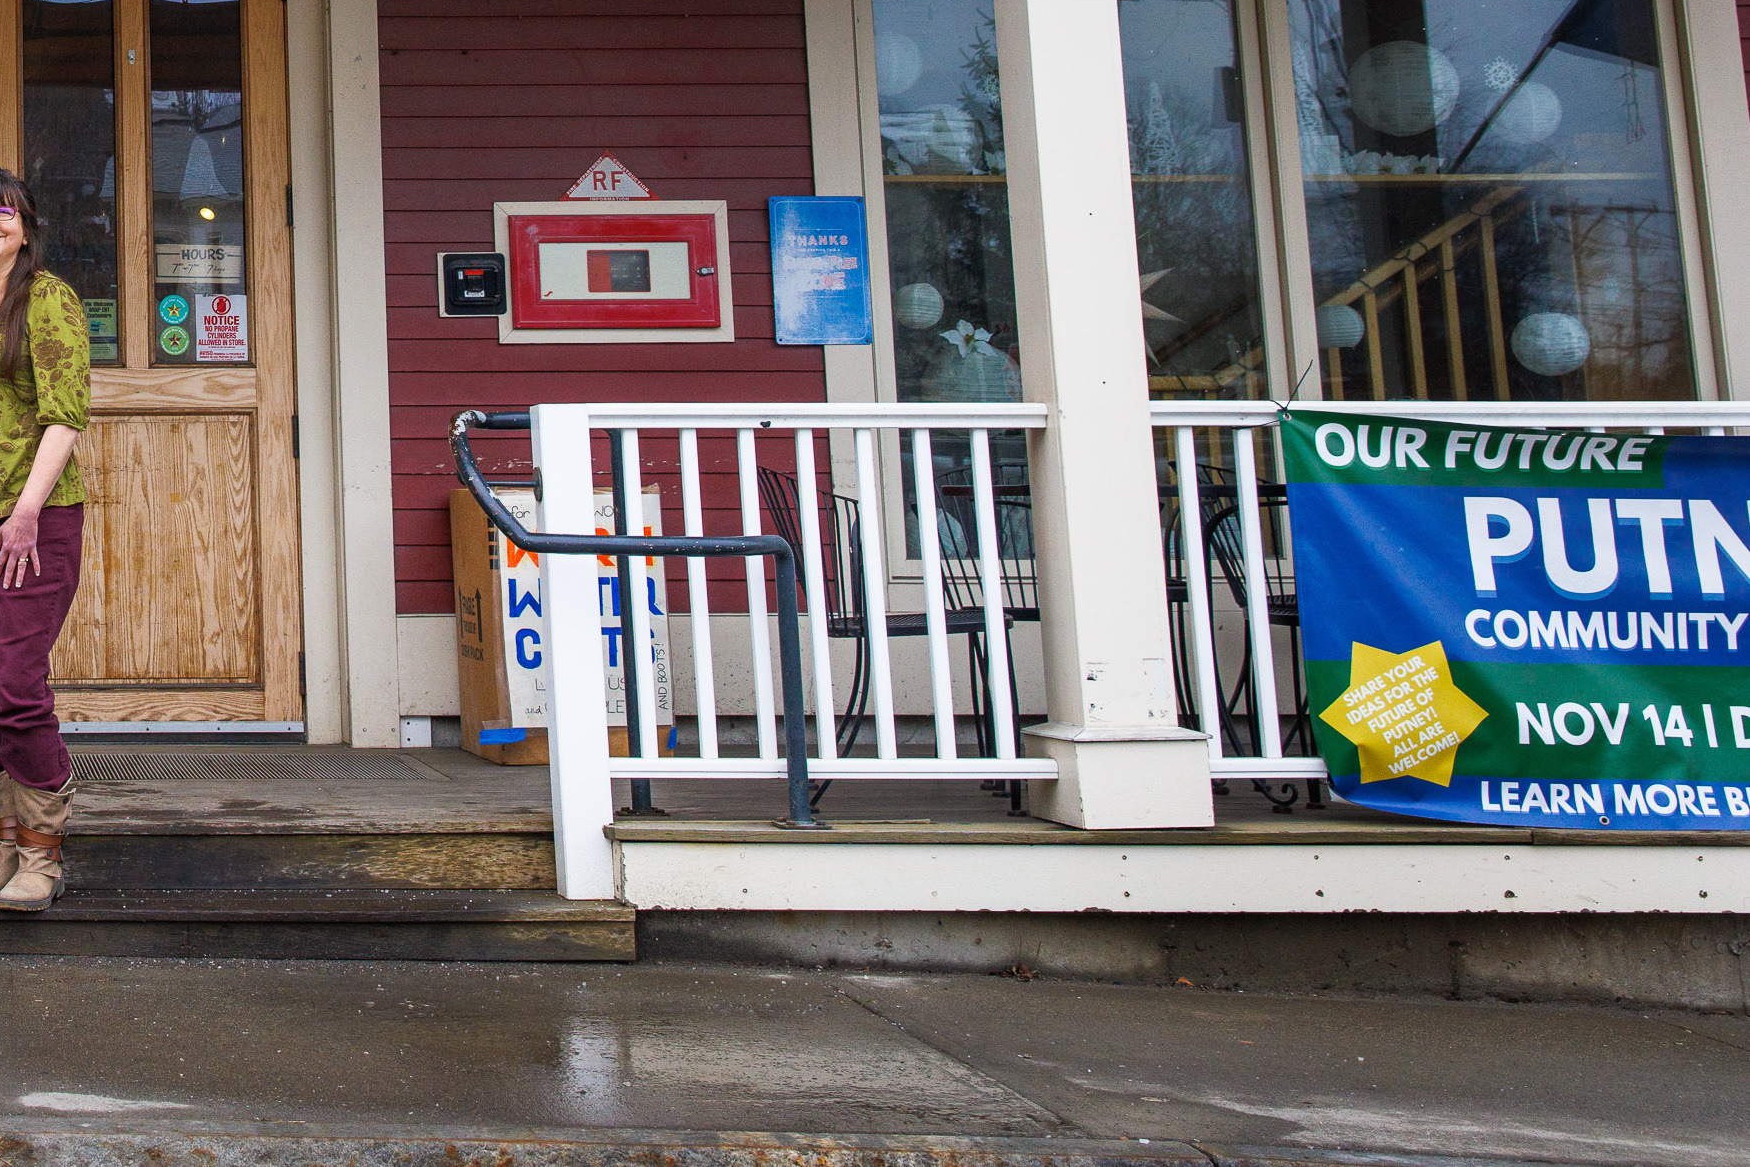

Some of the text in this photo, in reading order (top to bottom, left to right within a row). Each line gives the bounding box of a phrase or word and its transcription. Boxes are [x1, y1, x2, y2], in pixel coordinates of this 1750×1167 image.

[577, 157, 603, 184] DEPARTMENT
[593, 171, 623, 190] RF
[613, 158, 649, 192] CONSTRUCTION
[566, 185, 577, 195] FIRE
[181, 249, 225, 261] HOURS
[789, 235, 848, 246] THANKS
[203, 316, 239, 325] NOTICE
[1314, 422, 1653, 471] OUR FUTURE
[1465, 609, 1748, 650] COMMUNITY
[655, 643, 669, 710] AND BOOTS!
[1343, 656, 1426, 707] SHARE YOUR
[1346, 666, 1439, 725] IDEAS FOR THE
[1367, 688, 1434, 733] FUTURE OF
[1383, 706, 1438, 744] PUTNEY!
[1394, 721, 1445, 758] ALL ARE
[1517, 702, 1629, 745] NOV
[1642, 703, 1694, 747] 14
[1388, 731, 1460, 774] WELCOME!
[1481, 781, 1721, 817] LEARN MORE
